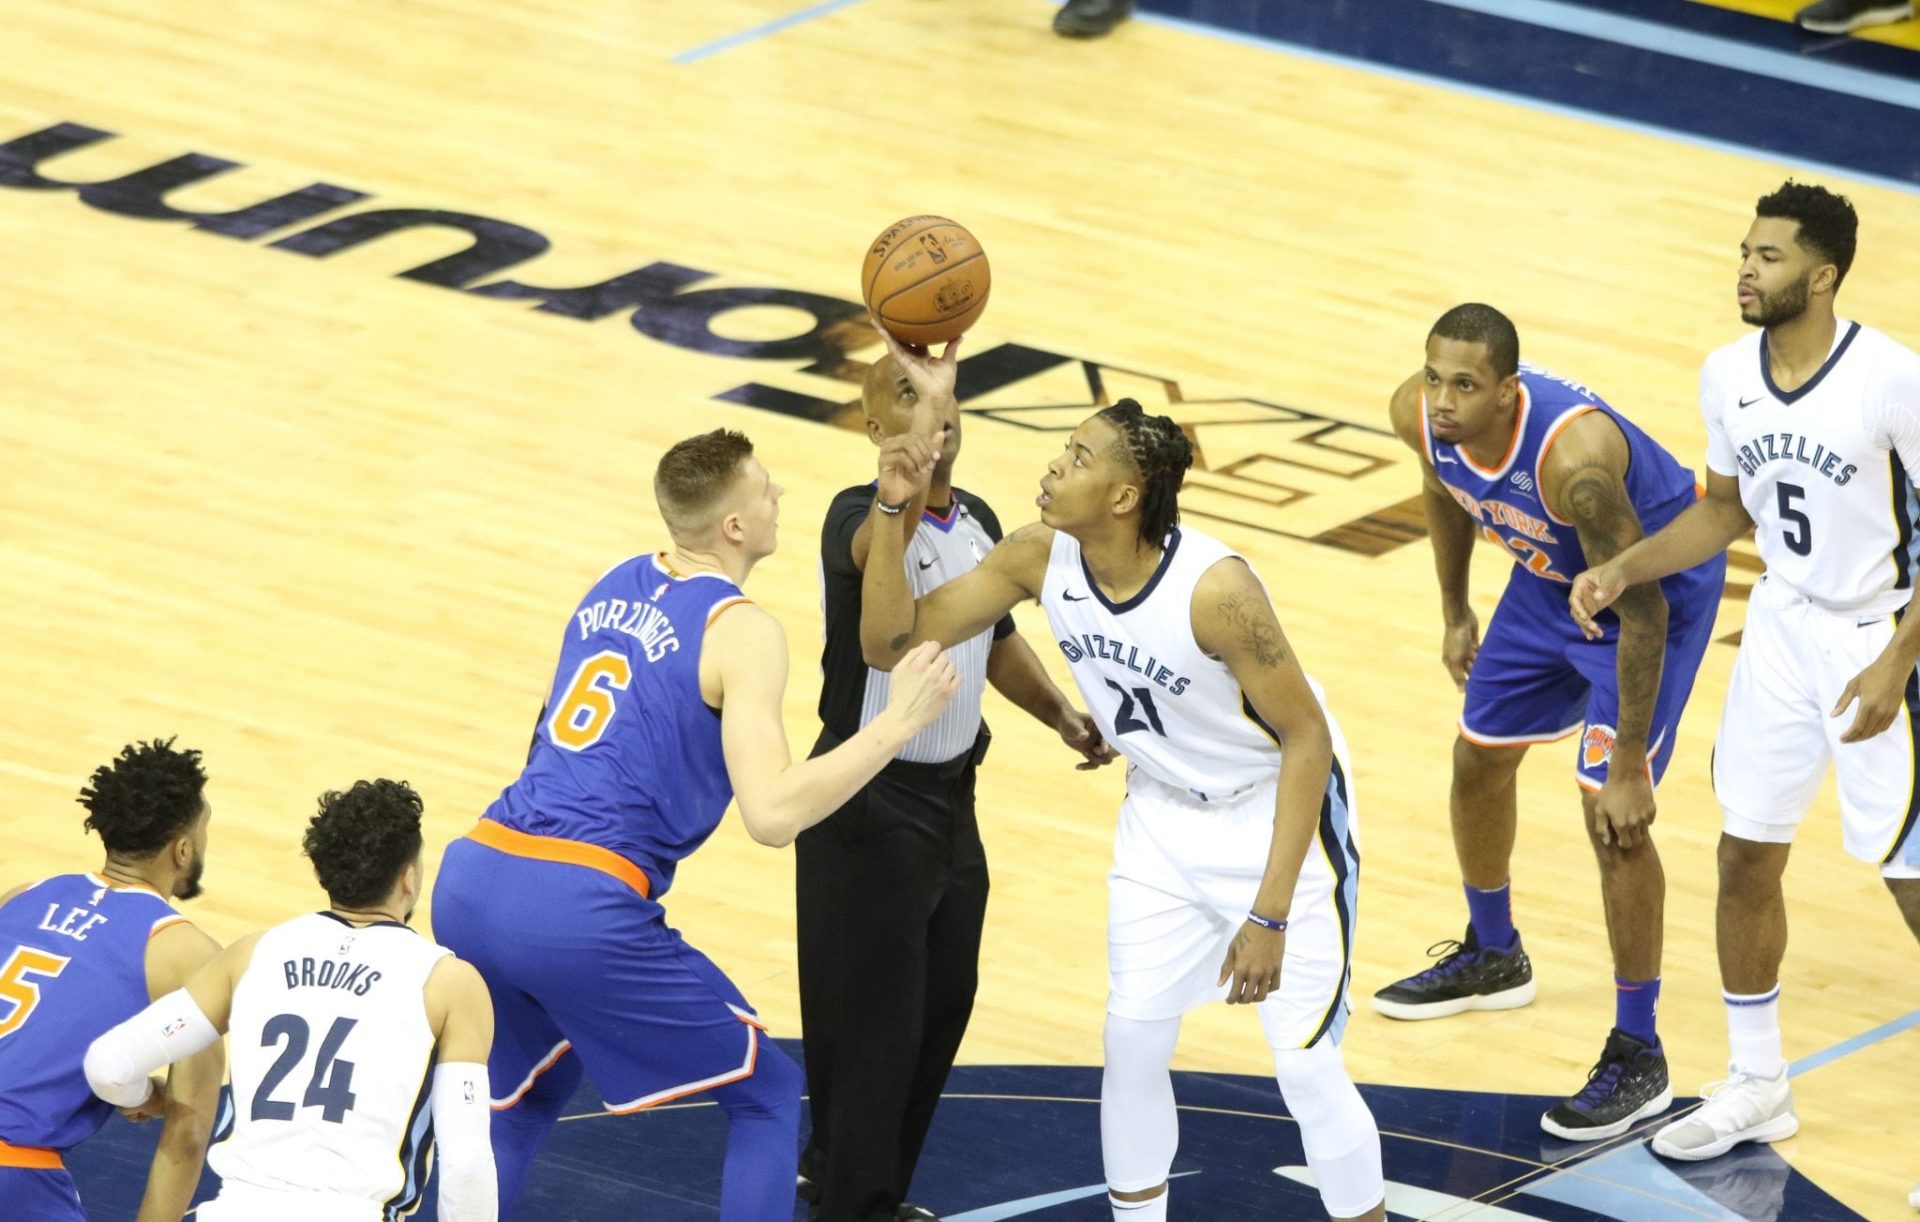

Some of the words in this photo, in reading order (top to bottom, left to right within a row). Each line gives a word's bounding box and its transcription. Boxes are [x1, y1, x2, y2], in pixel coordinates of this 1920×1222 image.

[1736, 433, 1858, 486] GRIZZLIES
[1480, 500, 1559, 544] YORK
[1776, 481, 1812, 557] 5
[576, 598, 680, 663] PORZINGIS
[1058, 634, 1191, 696] GIZZLIES
[547, 649, 633, 752] 6
[1104, 676, 1168, 737] 21
[38, 903, 108, 942] LEE
[283, 957, 382, 996] BROOKS
[251, 1013, 359, 1124] 24
